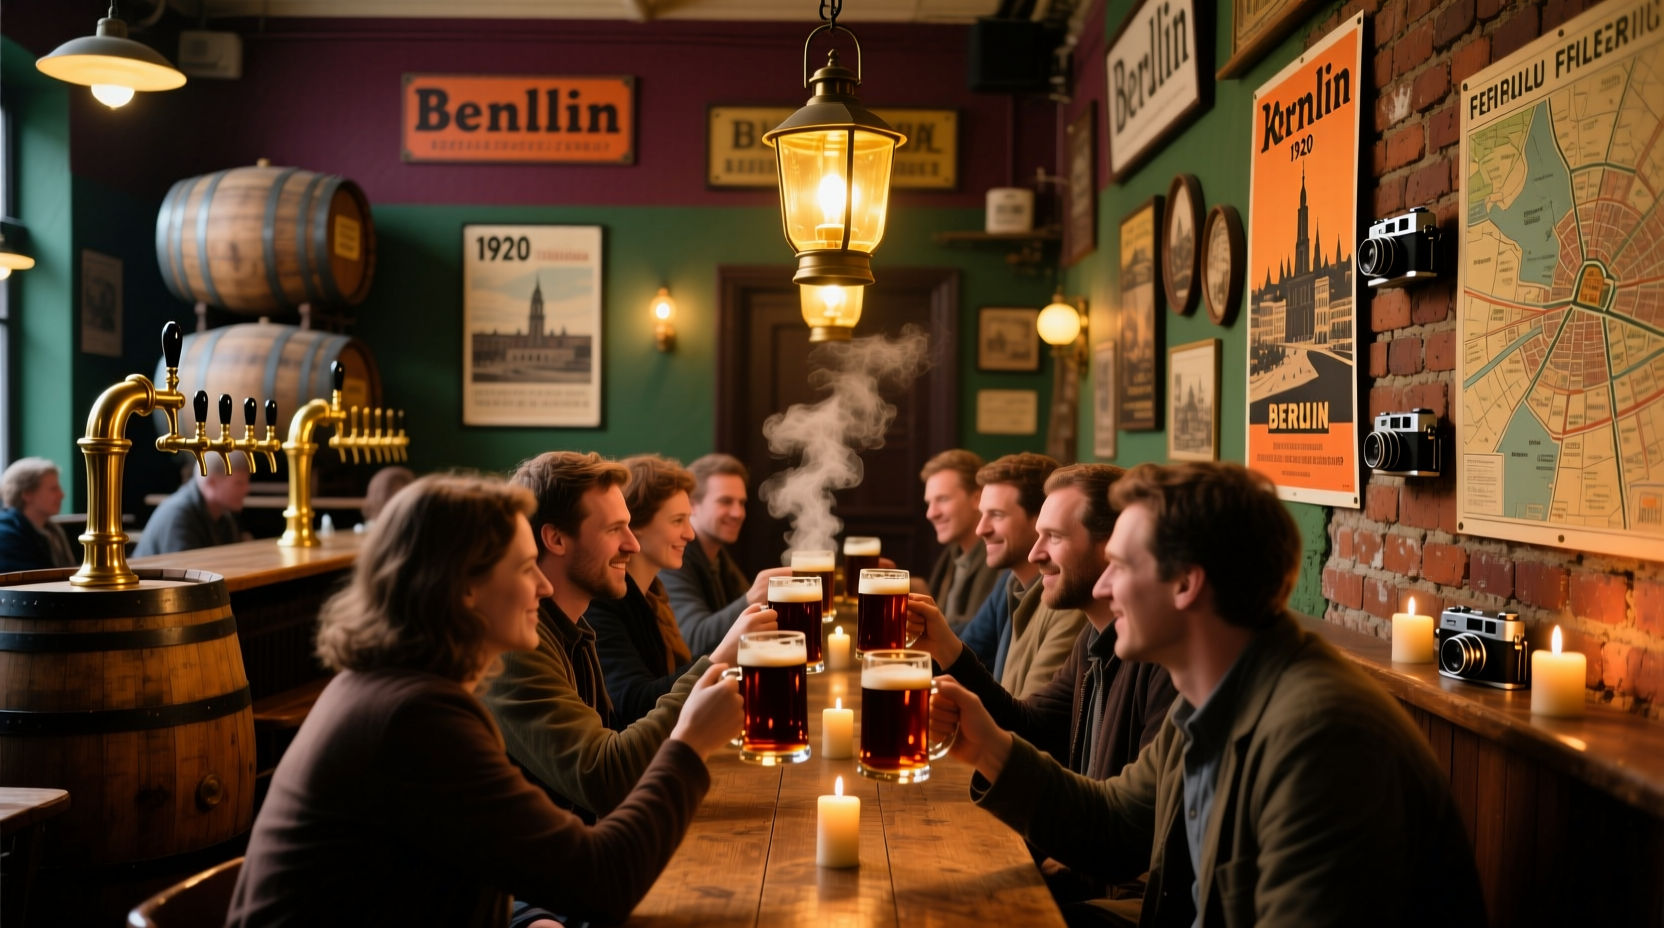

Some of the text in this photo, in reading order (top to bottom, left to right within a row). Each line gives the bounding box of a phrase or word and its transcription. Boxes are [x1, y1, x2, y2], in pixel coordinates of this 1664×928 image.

[414, 87, 620, 133] Benllin
[1290, 134, 1313, 162] 1920
[475, 236, 530, 262] 1920
